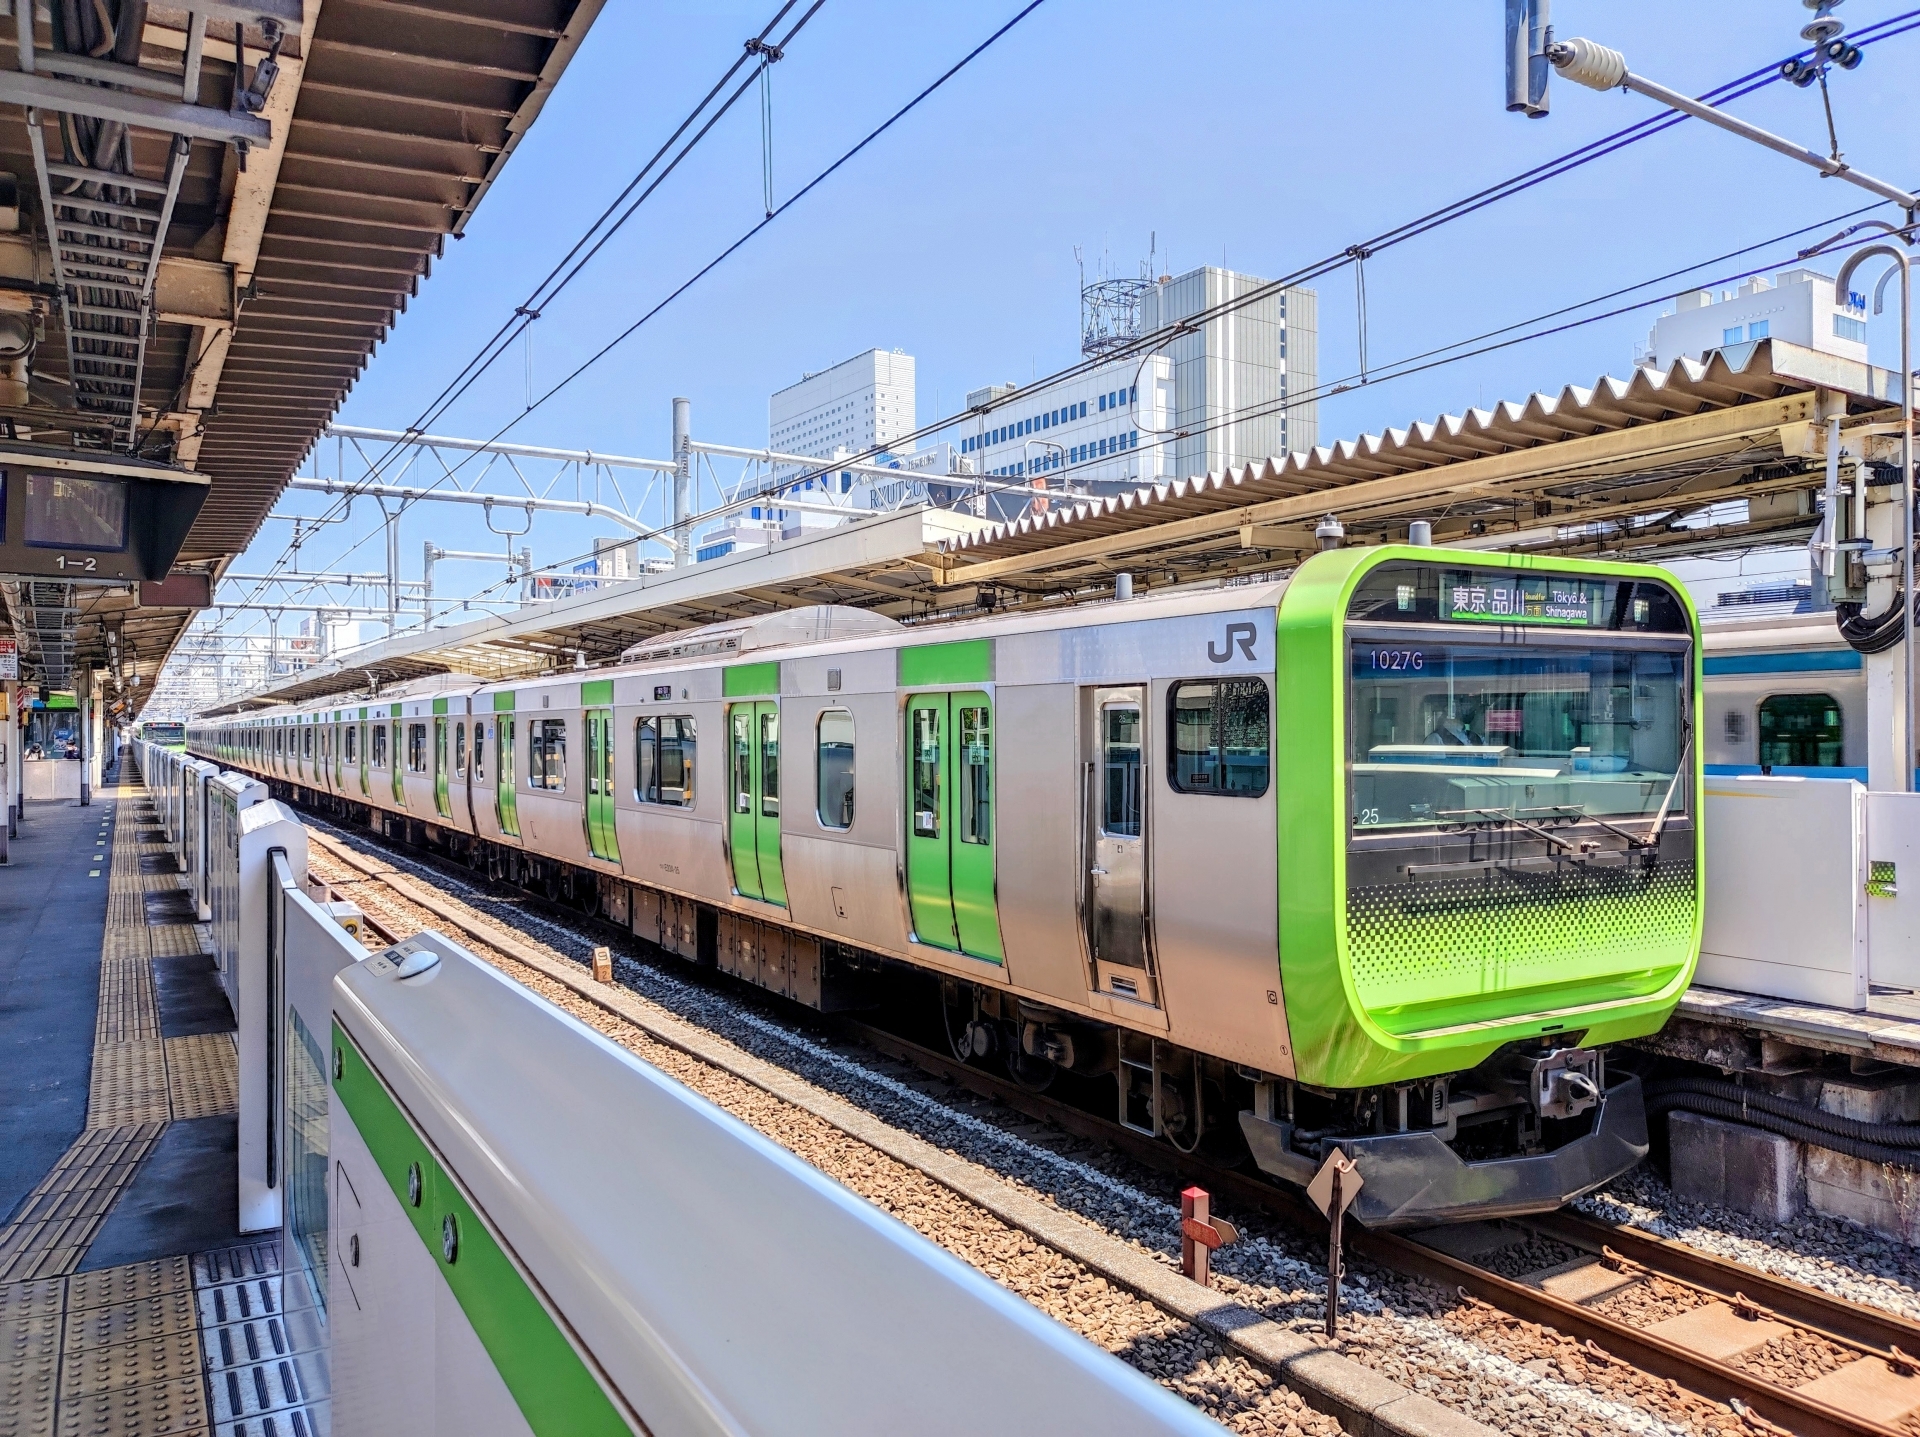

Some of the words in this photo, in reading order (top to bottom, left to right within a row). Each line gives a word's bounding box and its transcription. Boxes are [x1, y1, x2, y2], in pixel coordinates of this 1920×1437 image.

[1579, 592, 1587, 604] &
[1525, 605, 1541, 617] 方面
[1545, 605, 1587, 620] Shinagawa
[1208, 622, 1257, 663] JR
[1370, 650, 1423, 670] 1027G
[1361, 808, 1379, 825] 25
[602, 970, 608, 980] 2
